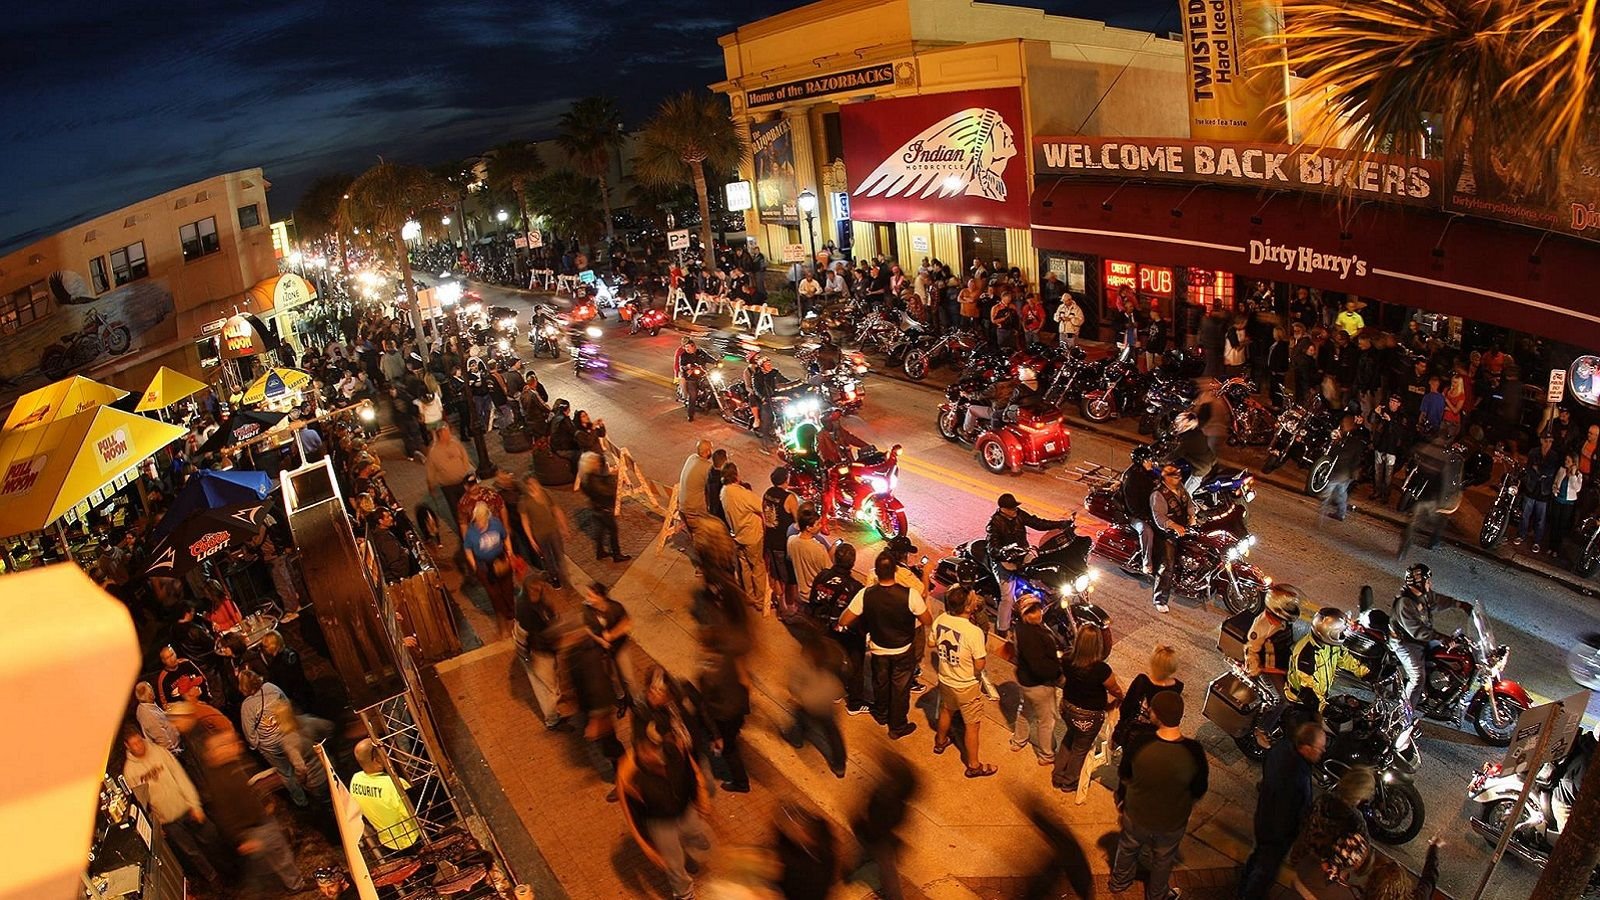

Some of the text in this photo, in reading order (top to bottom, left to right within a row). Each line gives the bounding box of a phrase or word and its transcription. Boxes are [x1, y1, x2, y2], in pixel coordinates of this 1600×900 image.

[1188, 0, 1214, 103] TWISTED
[1209, 0, 1232, 83] Hard Iced
[749, 67, 893, 105] Home of the RAZORBACKS
[1230, 119, 1248, 127] Taste
[903, 139, 965, 163] Indian
[1042, 143, 1431, 198] WELCOME BACK BIKERS
[1249, 238, 1367, 280] Dirty Harry's
[1141, 268, 1171, 293] PUB
[227, 337, 253, 351] MOON
[238, 428, 259, 441] LIGHT
[103, 440, 128, 463] MOON
[1, 471, 39, 495] MOON
[188, 531, 231, 557] Coors
[197, 538, 231, 562] LIGHT
[352, 783, 383, 799] SECURITY
